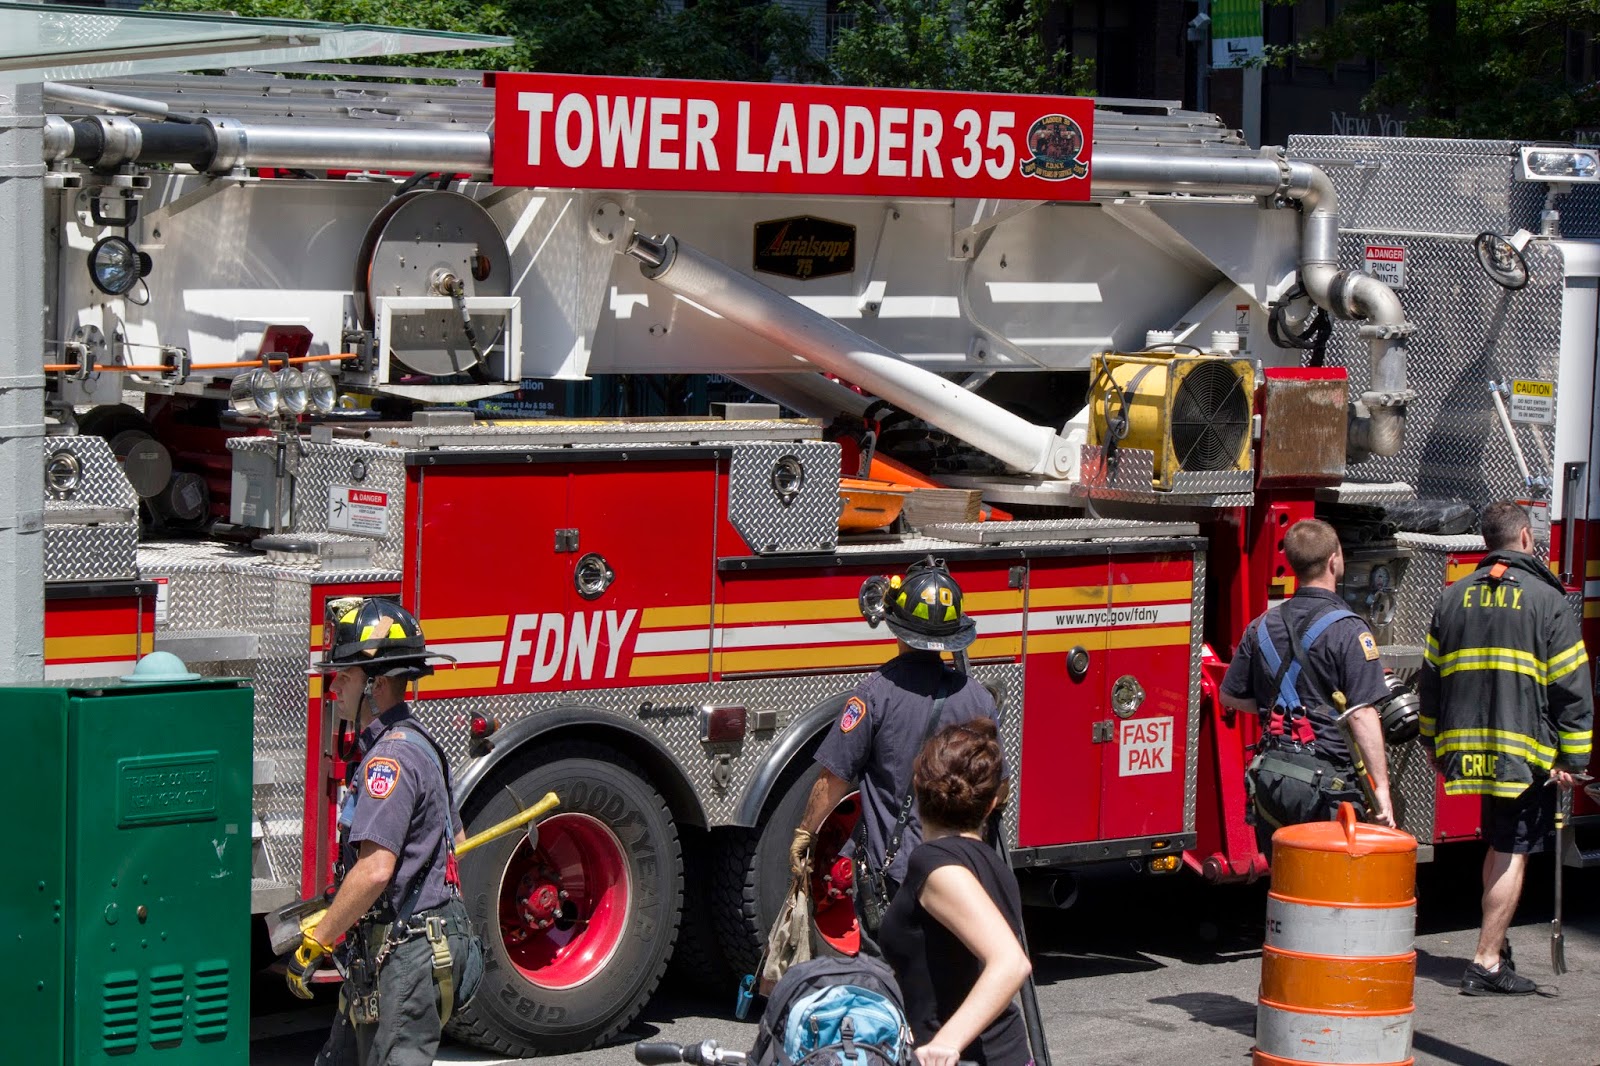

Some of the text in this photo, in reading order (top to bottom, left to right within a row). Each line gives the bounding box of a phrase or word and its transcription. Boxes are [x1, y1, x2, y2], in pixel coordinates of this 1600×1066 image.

[1042, 116, 1063, 125] LADDER
[517, 91, 1016, 180] TOWER LADDER 35
[760, 221, 850, 262] Aerialscope
[1374, 248, 1403, 260] DANGER
[797, 259, 814, 276] 75
[1371, 262, 1397, 272] PINCH
[1380, 273, 1399, 284] INTS
[520, 379, 544, 391] ation
[1515, 383, 1550, 395] CAUTION
[359, 493, 383, 503] DANGER
[921, 586, 953, 607] 40
[1056, 607, 1159, 627] www.nyc.gov/fdny
[503, 608, 638, 685] FDNY
[1122, 721, 1171, 745] FAST
[1128, 746, 1165, 771] PAK
[501, 983, 568, 1025] G182
